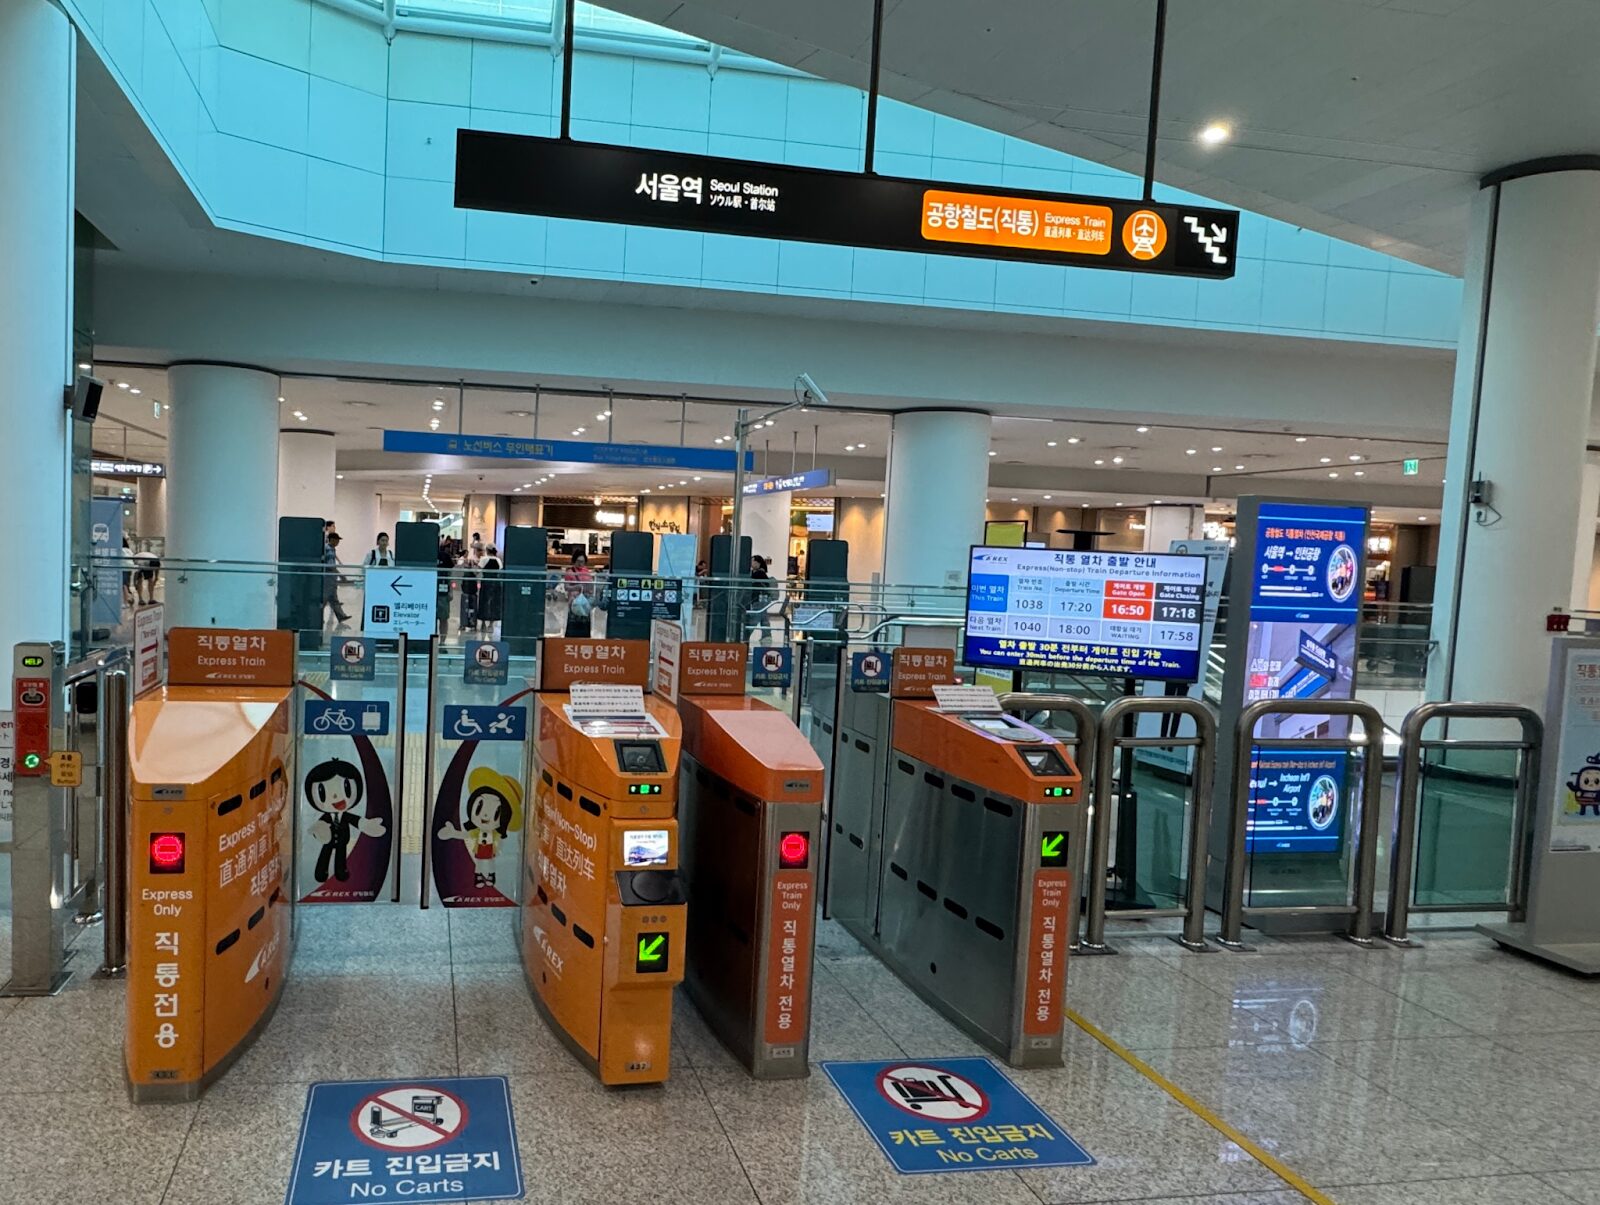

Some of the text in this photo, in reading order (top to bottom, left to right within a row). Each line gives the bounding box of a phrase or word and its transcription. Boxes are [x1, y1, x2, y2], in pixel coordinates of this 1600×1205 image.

[635, 172, 703, 204] 서울역
[710, 178, 779, 197] Seoul Station
[926, 202, 1040, 237] 공항철도(직통)
[1045, 212, 1106, 228] Express Train
[1264, 545, 1286, 560] 서울역
[1294, 546, 1321, 562] 인천공항
[1054, 553, 1157, 568] 직통 열차 출발 안내
[1017, 563, 1201, 579] Express(Non-stop) Train Departure Information
[971, 585, 1005, 594] 이번 열차
[1016, 599, 1043, 610] 1038
[1061, 601, 1092, 612] 17:20
[1111, 604, 1145, 616] 16:50
[969, 616, 1002, 624] 다음 열차
[1162, 606, 1196, 619] 17:18
[1014, 621, 1042, 632] 1040
[1059, 624, 1091, 635] 18:00
[197, 635, 267, 652] 직통열차
[1160, 630, 1194, 642] 17:58
[564, 644, 626, 660] 직통열차
[688, 648, 740, 663] 직통열차
[999, 640, 1162, 659] 열차 출발 30분 전부터 게이트 진입 가능
[24, 658, 43, 666] HELP
[197, 655, 266, 667] Express Train
[899, 654, 948, 668] 직통열차
[979, 648, 991, 656] You
[1025, 651, 1046, 659] 30min
[1048, 653, 1070, 661] before
[1085, 655, 1119, 664] departure
[1121, 657, 1136, 665] time
[1148, 659, 1159, 667] the
[1161, 661, 1181, 669] Train.
[563, 663, 625, 675] Express Train
[687, 666, 739, 676] Express Train
[897, 671, 946, 681] Express Train
[1576, 663, 1600, 679] 직통
[219, 820, 256, 852] Express
[777, 881, 808, 892] Express
[1038, 879, 1067, 889] Express
[142, 888, 193, 901] Express
[782, 891, 803, 901] Train
[1042, 888, 1062, 898] Train
[153, 903, 182, 917] Only
[782, 901, 802, 912] Only
[1042, 898, 1060, 908] Only
[541, 939, 564, 973] AREX
[779, 919, 798, 990] 직통열차
[1039, 916, 1056, 983] 직통열차
[154, 931, 180, 1049] 직통전용
[777, 995, 793, 1030] 전용
[1036, 988, 1051, 1022] 전용
[888, 1122, 1055, 1147] 카트 진입금지
[936, 1146, 1039, 1164] No Carts
[312, 1150, 501, 1180] 카트 진입금지
[350, 1177, 464, 1198] No Carts
